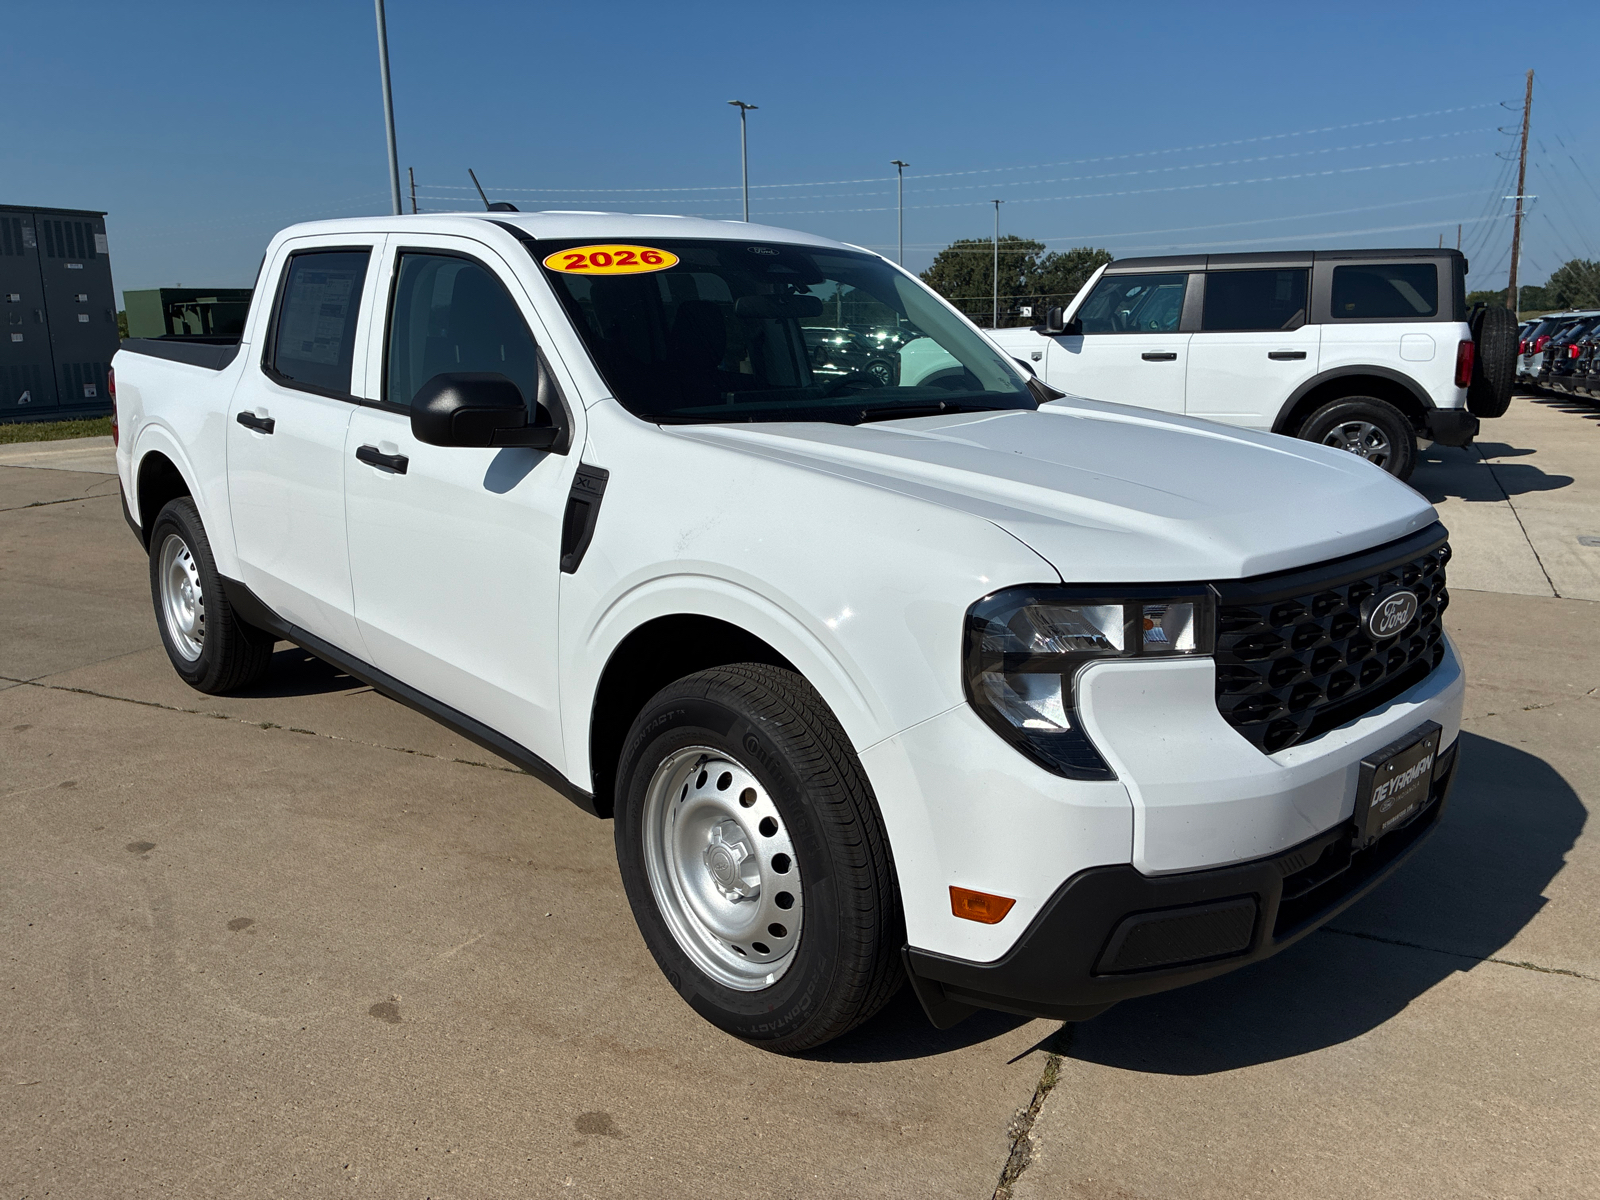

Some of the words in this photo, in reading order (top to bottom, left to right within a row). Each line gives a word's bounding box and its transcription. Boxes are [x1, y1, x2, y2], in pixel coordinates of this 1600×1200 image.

[562, 250, 664, 270] 2026
[575, 476, 596, 490] XL
[1379, 597, 1411, 632] Ford
[1370, 752, 1435, 808] DEYARMAN
